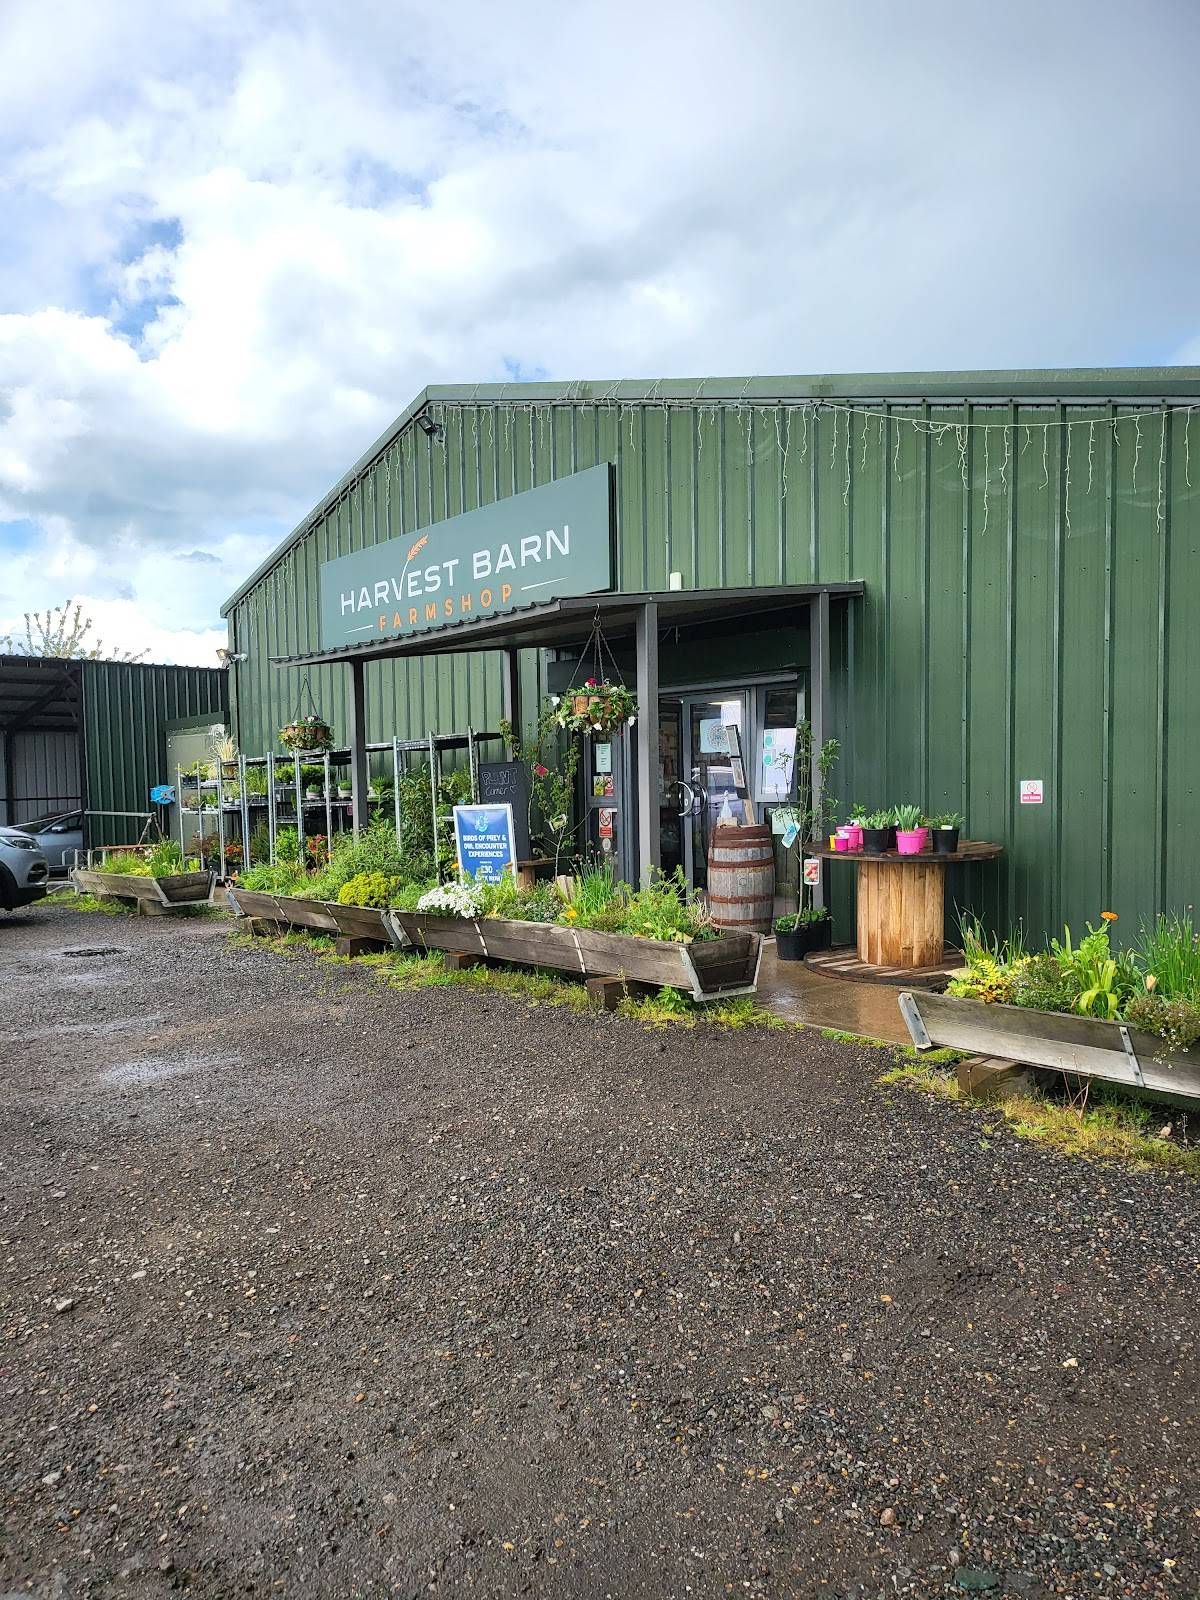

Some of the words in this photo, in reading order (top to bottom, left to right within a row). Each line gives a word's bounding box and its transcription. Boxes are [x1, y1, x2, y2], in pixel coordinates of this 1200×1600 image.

[340, 559, 459, 616] HARVEST
[472, 524, 570, 580] BARN
[378, 583, 512, 632] FARMSHOP
[475, 842, 507, 850] ENCOUNTER
[486, 834, 501, 842] PREY
